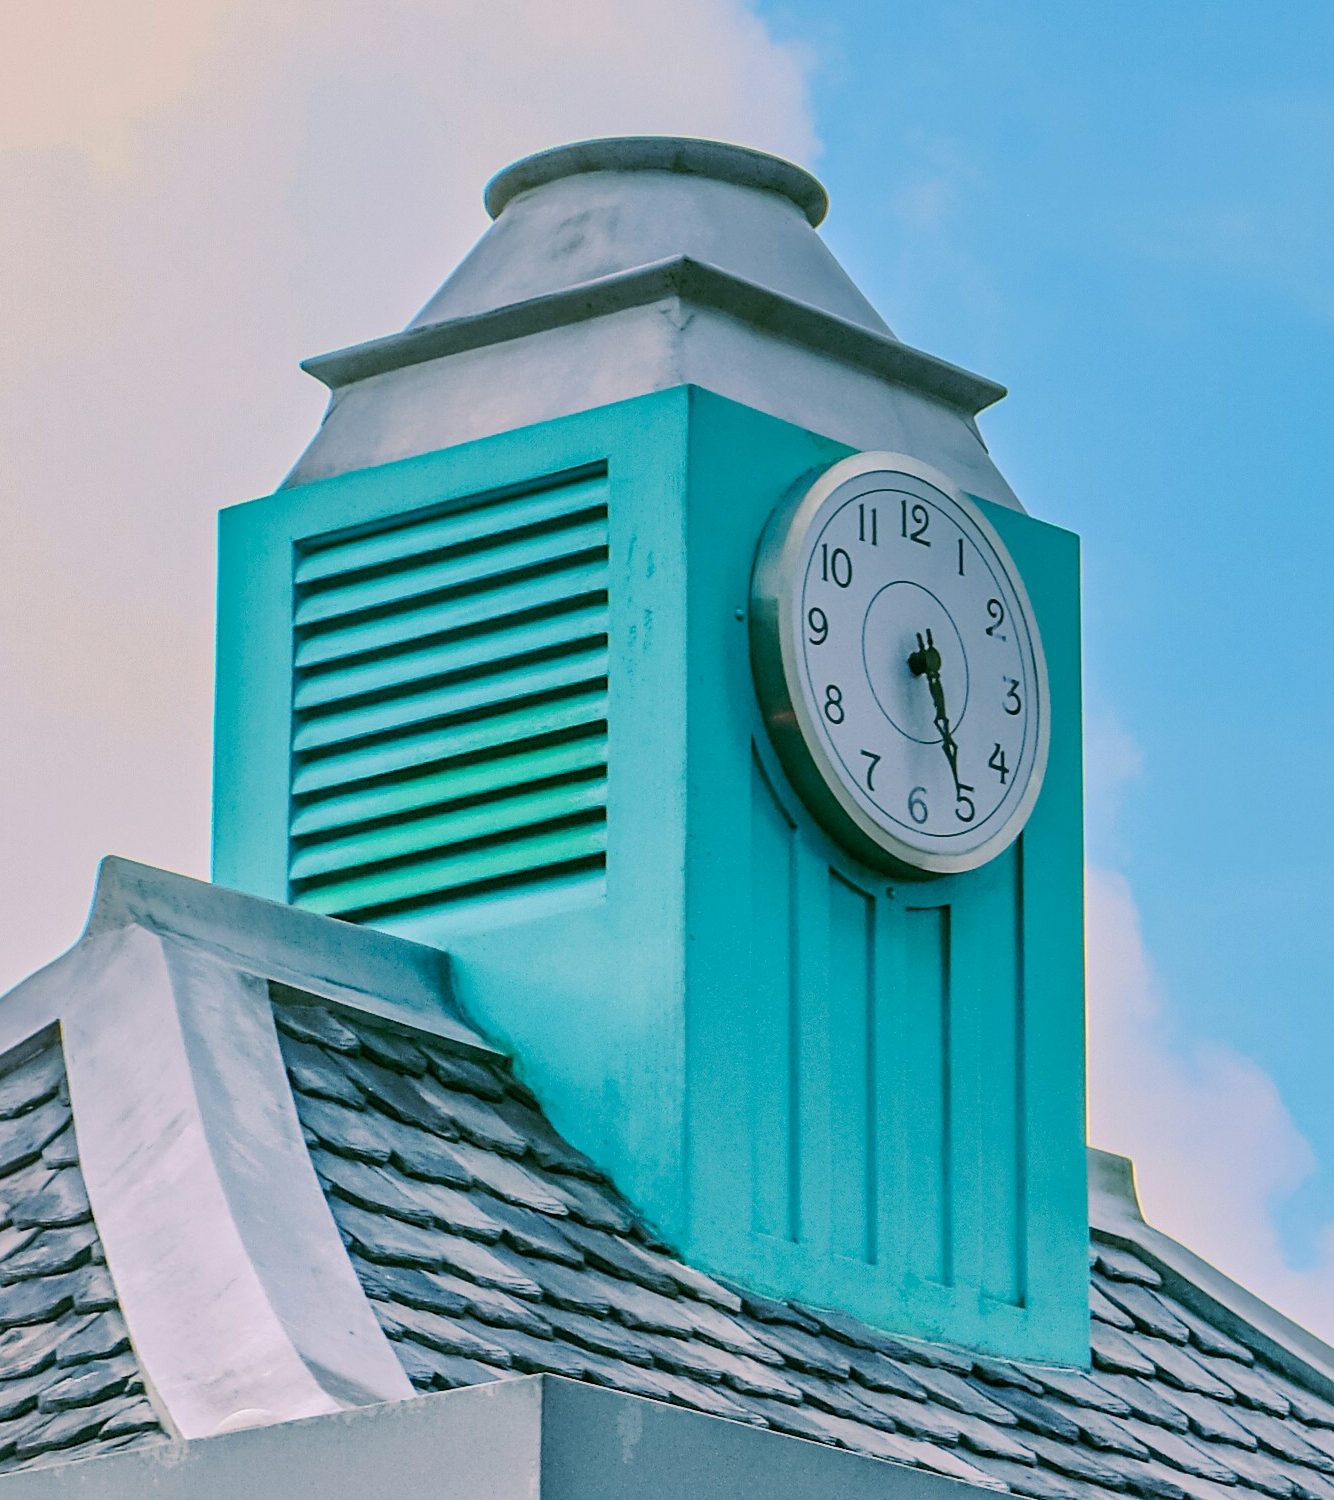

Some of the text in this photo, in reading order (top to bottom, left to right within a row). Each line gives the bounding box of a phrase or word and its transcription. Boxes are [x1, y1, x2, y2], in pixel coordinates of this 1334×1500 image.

[858, 503, 878, 546] 11
[900, 499, 932, 547] 12
[821, 543, 854, 588] 10
[957, 537, 966, 577] 1
[807, 606, 829, 646] 9
[985, 598, 1007, 643] 2
[823, 683, 846, 725] 8
[1002, 675, 1022, 716] 3
[859, 748, 882, 793] 7
[987, 742, 1010, 785] 4
[907, 785, 929, 825] 6
[954, 781, 976, 823] 5
